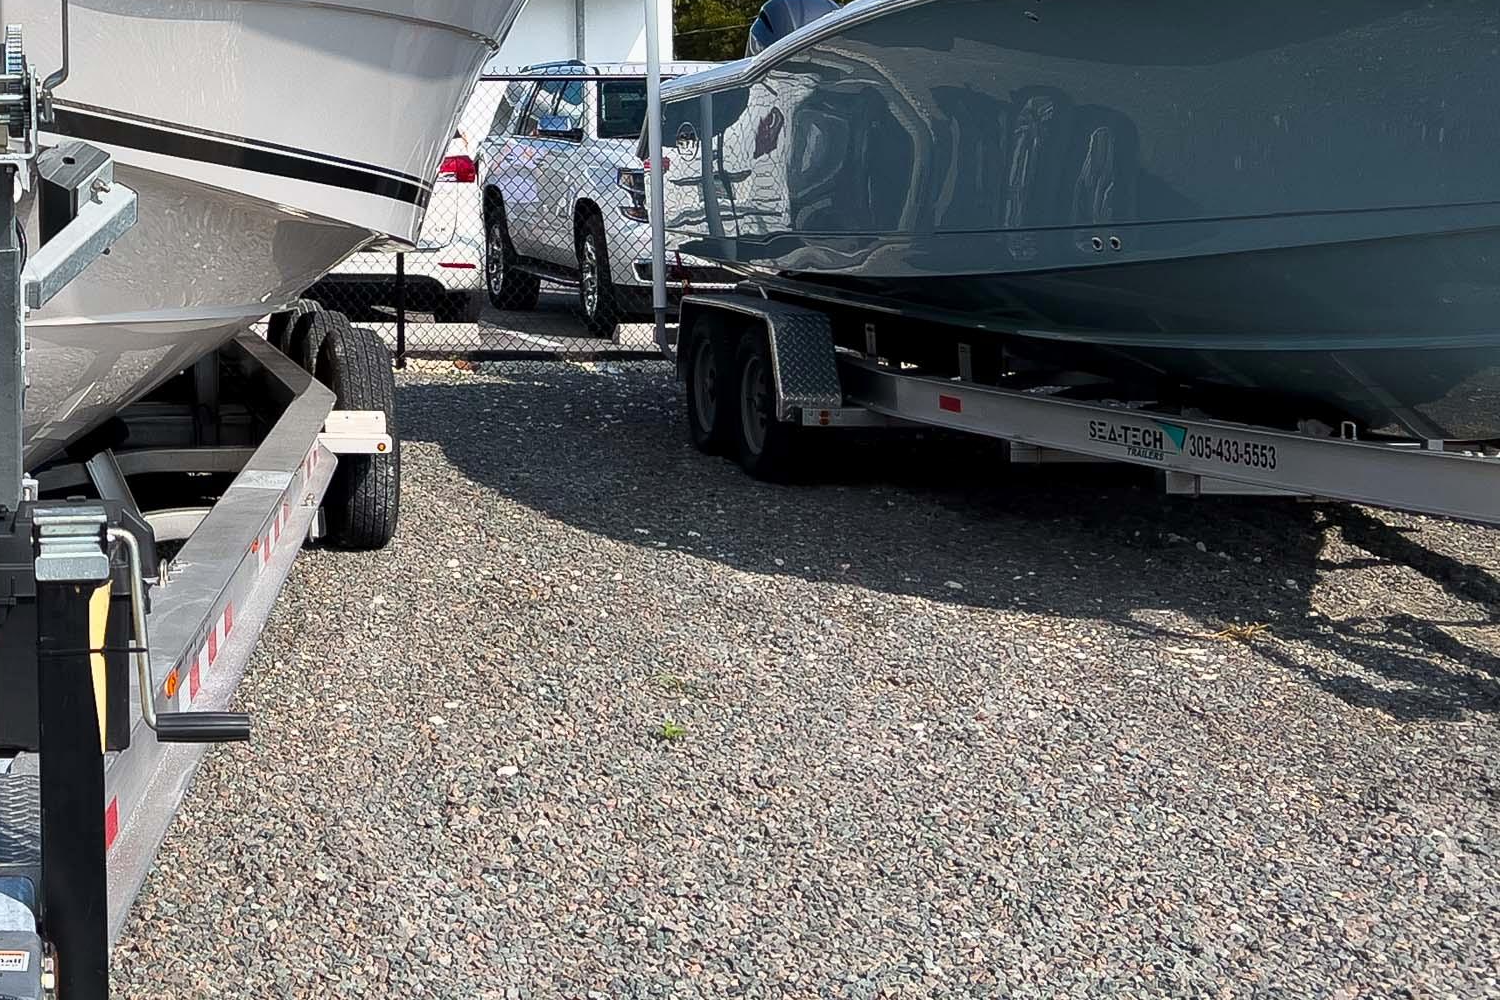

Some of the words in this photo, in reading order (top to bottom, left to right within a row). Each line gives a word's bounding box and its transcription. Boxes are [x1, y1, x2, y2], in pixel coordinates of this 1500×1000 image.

[1089, 420, 1164, 450] SEA-TECH
[1126, 446, 1164, 461] TRAILERS
[1189, 434, 1277, 470] 305-433-5553
